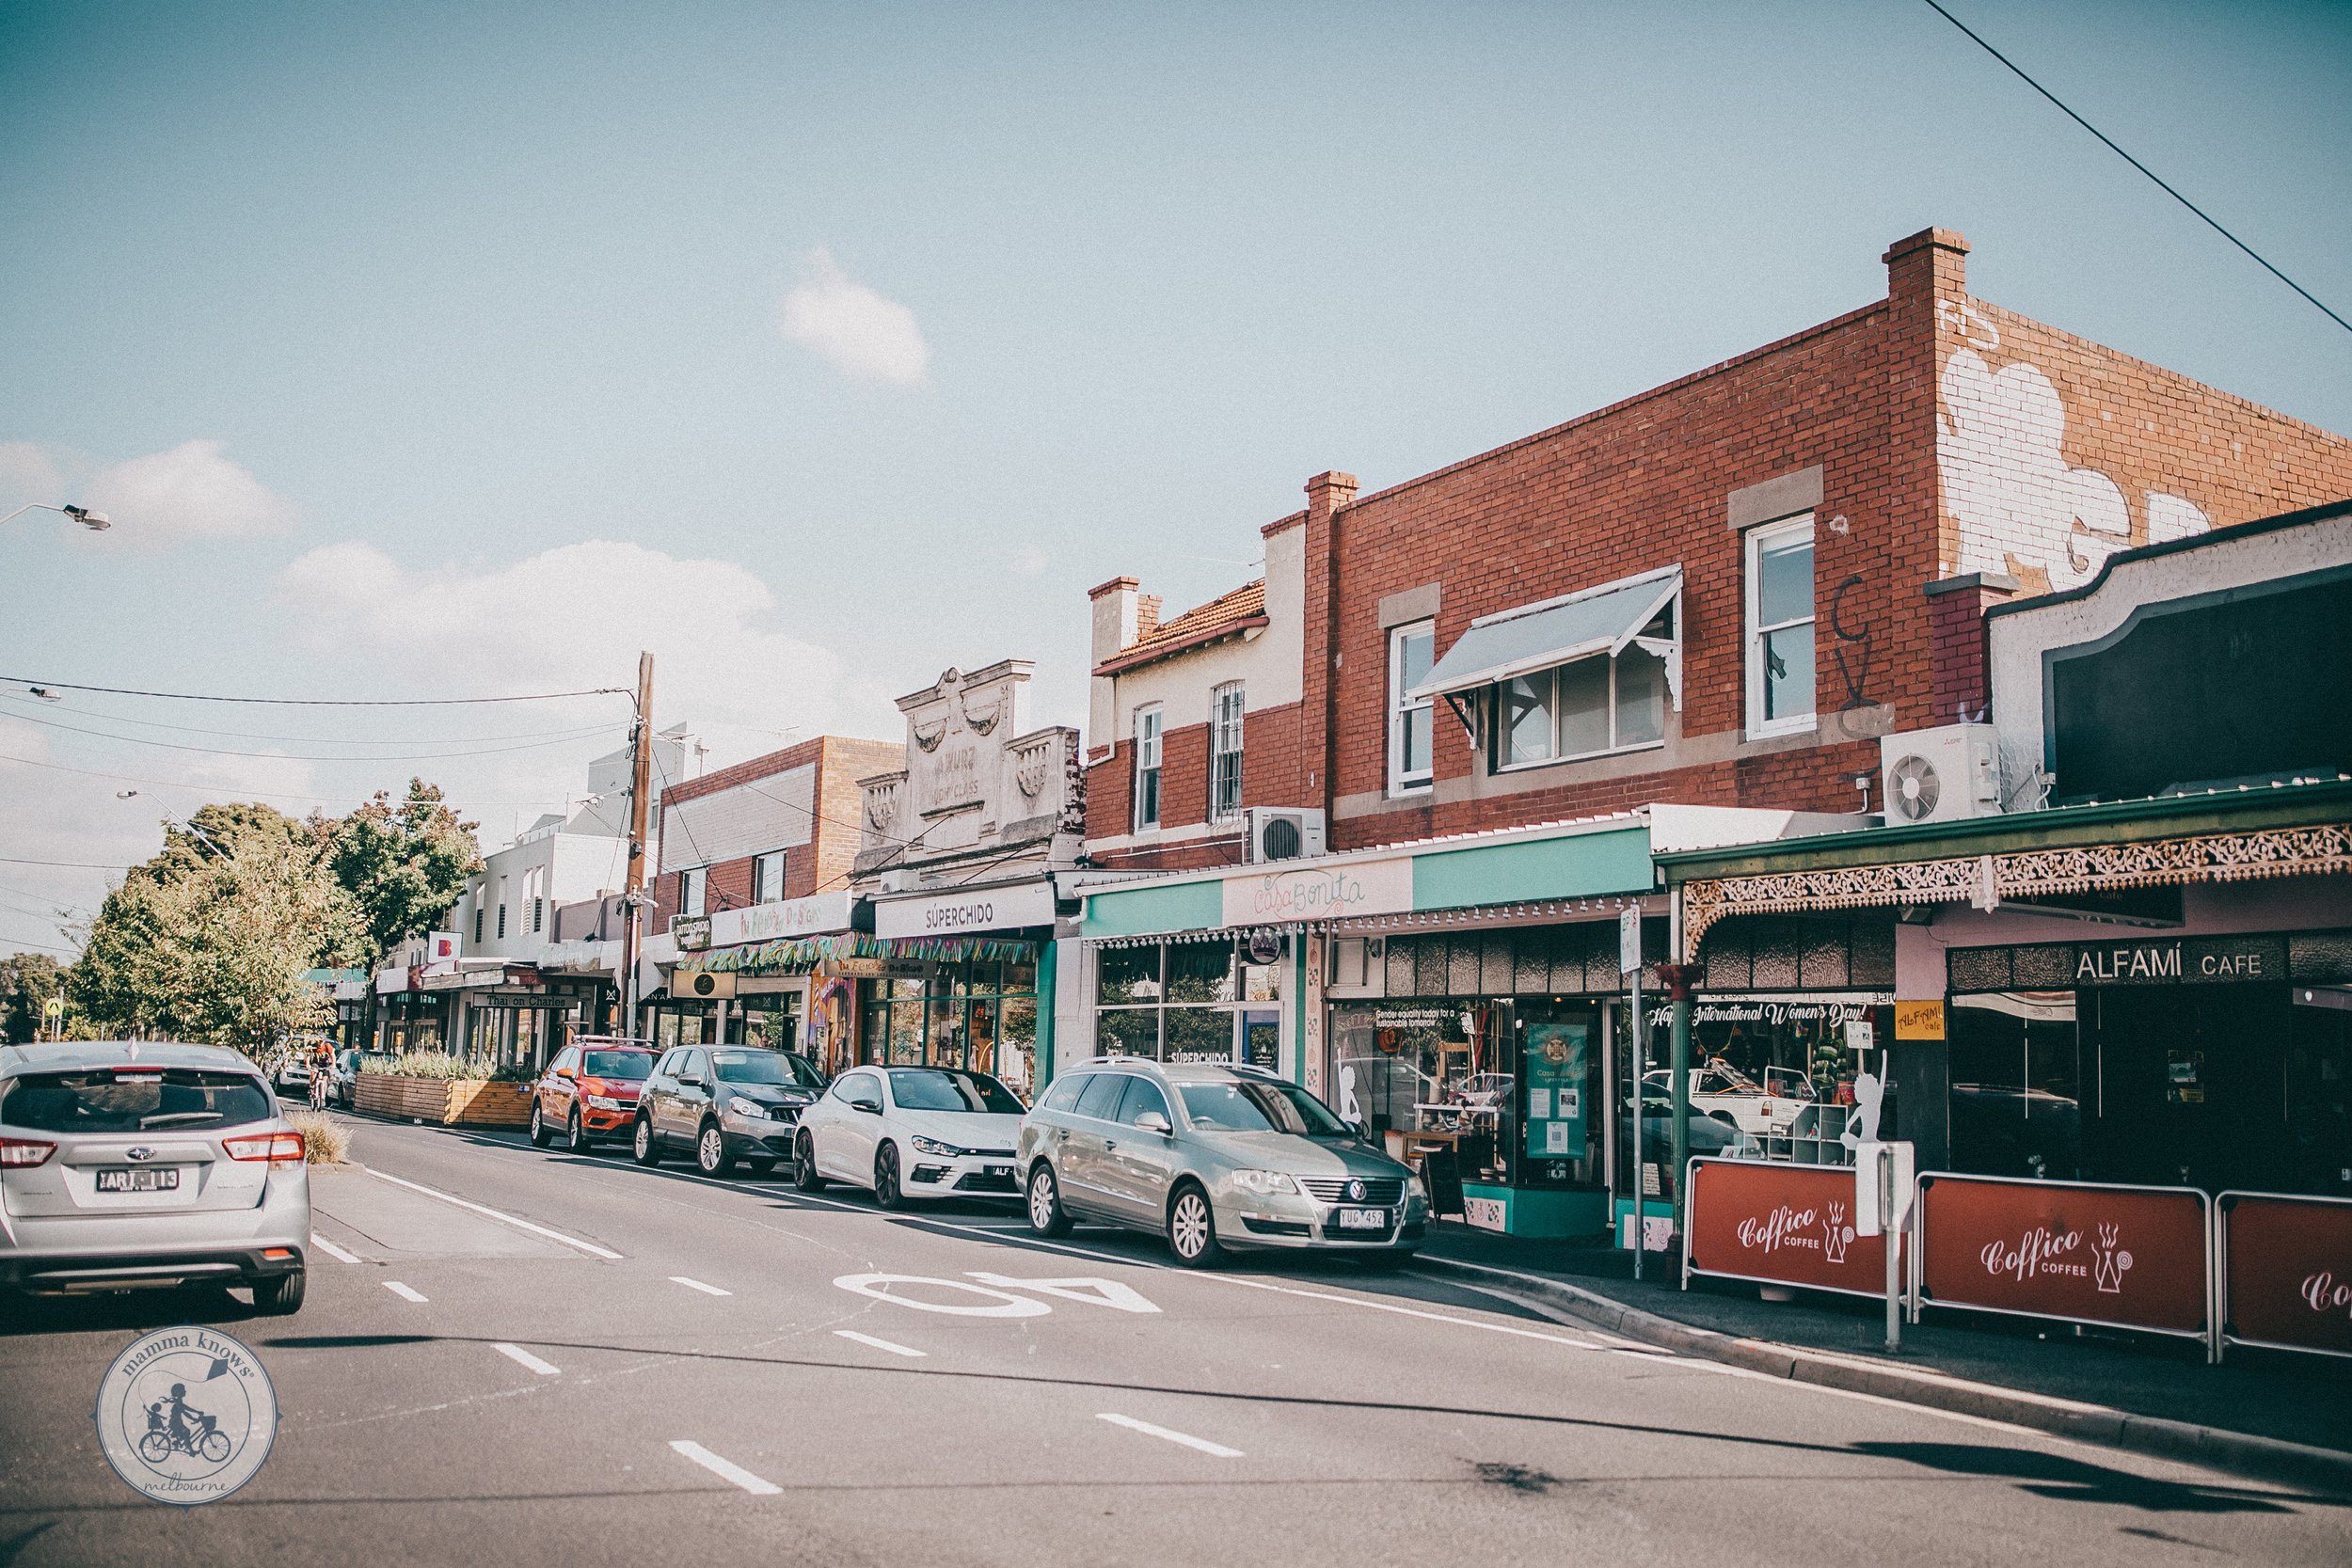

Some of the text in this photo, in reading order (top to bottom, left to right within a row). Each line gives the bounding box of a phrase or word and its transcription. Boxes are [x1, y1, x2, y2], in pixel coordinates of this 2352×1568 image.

[926, 903, 993, 928] SÚPERCHIDO
[2076, 942, 2262, 979] ALFAMÍ CAFE
[487, 995, 566, 1007] Thai on Charles
[1375, 1009, 1397, 1019] Gender
[1398, 1009, 1422, 1021] equality
[1422, 1008, 1439, 1019] today
[1440, 1008, 1449, 1017] for
[1375, 1019, 1436, 1028] sustainable tomorrow
[1649, 1002, 1867, 1028] Hap International Women's Day!
[1366, 1212, 1383, 1224] 452
[1737, 1205, 1818, 1254] Coffico
[1784, 1236, 1820, 1250] COFFEE
[1980, 1227, 2084, 1282] Coffico
[2041, 1262, 2088, 1277] COFFEE
[2301, 1272, 2352, 1320] Co
